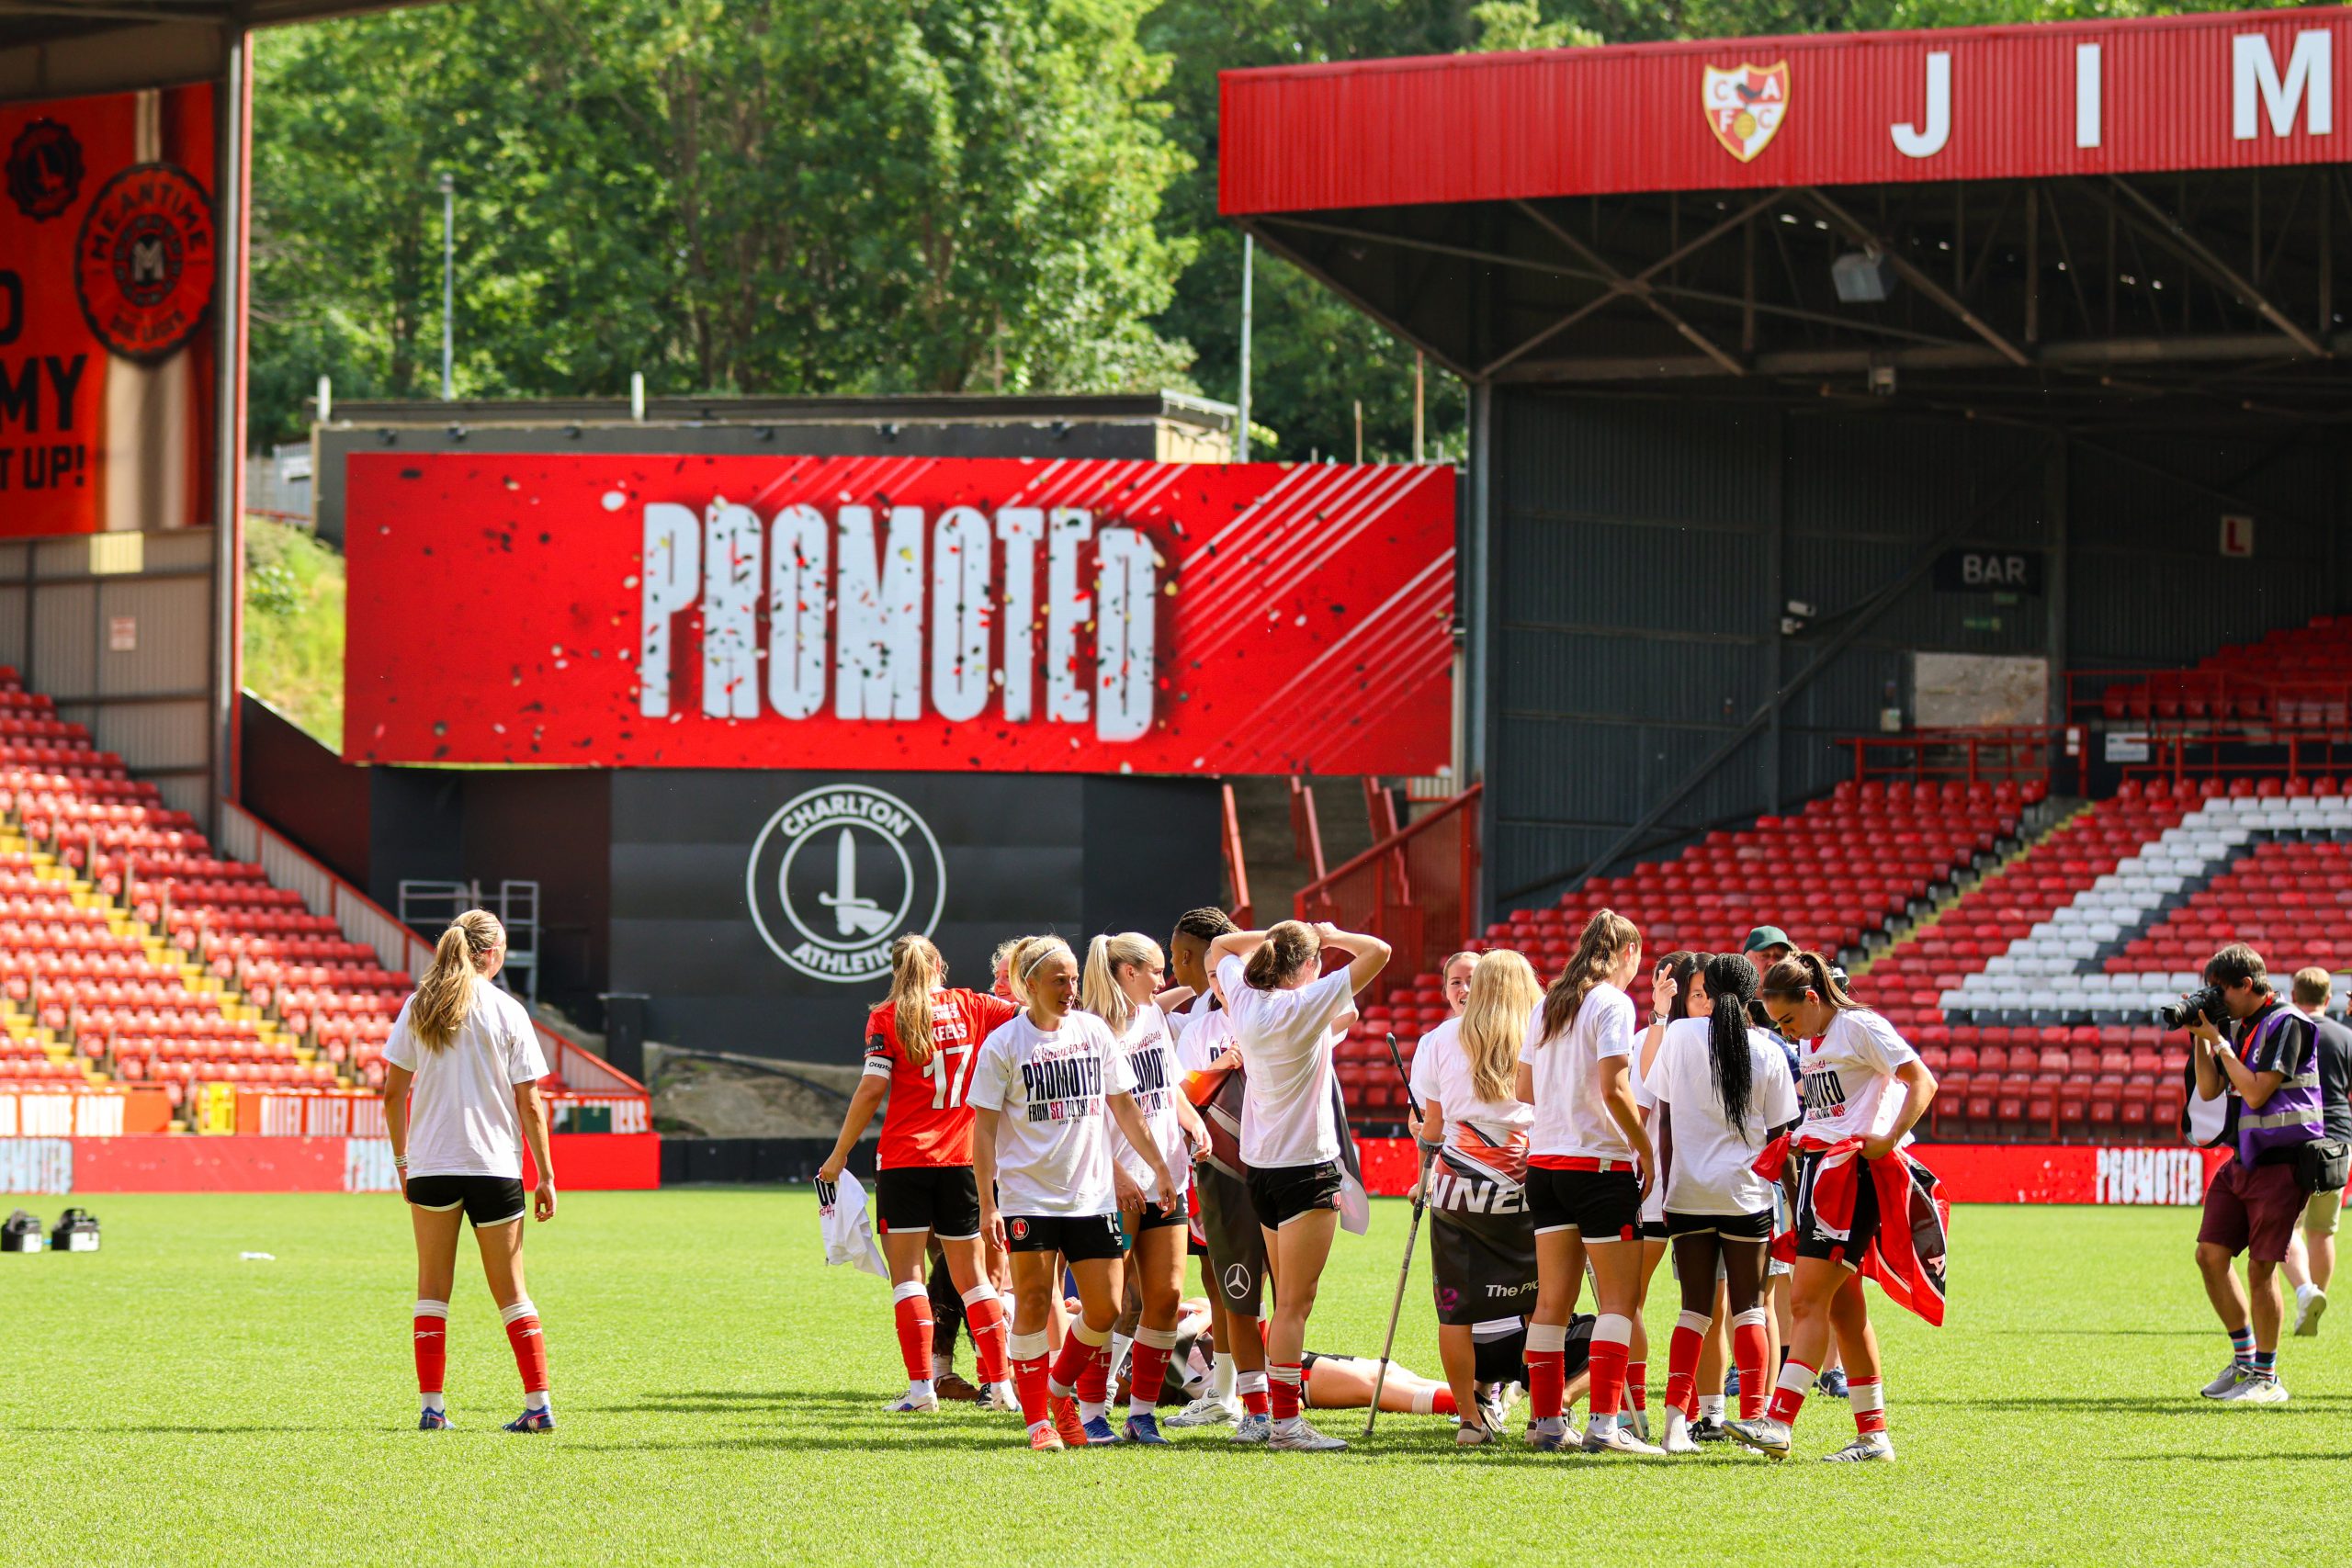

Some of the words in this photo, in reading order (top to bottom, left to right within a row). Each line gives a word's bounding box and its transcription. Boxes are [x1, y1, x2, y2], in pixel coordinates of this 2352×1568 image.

[1761, 74, 1781, 101] A
[1719, 108, 1735, 132] F
[1758, 109, 1773, 130] C
[90, 182, 209, 261] MEANTIME
[23, 445, 85, 491] UP!
[1962, 554, 2027, 585] BAR
[640, 502, 1156, 742] PROMOTED
[781, 794, 912, 838] CHARLTON
[791, 940, 894, 975] ATHLETIC
[922, 1043, 973, 1110] 17
[1021, 1056, 1102, 1102] PROMOTED
[1028, 1103, 1049, 1122] FROM
[1066, 1100, 1076, 1118] TO
[2096, 1147, 2203, 1205] PROMOTED
[1486, 1283, 1519, 1298] The
